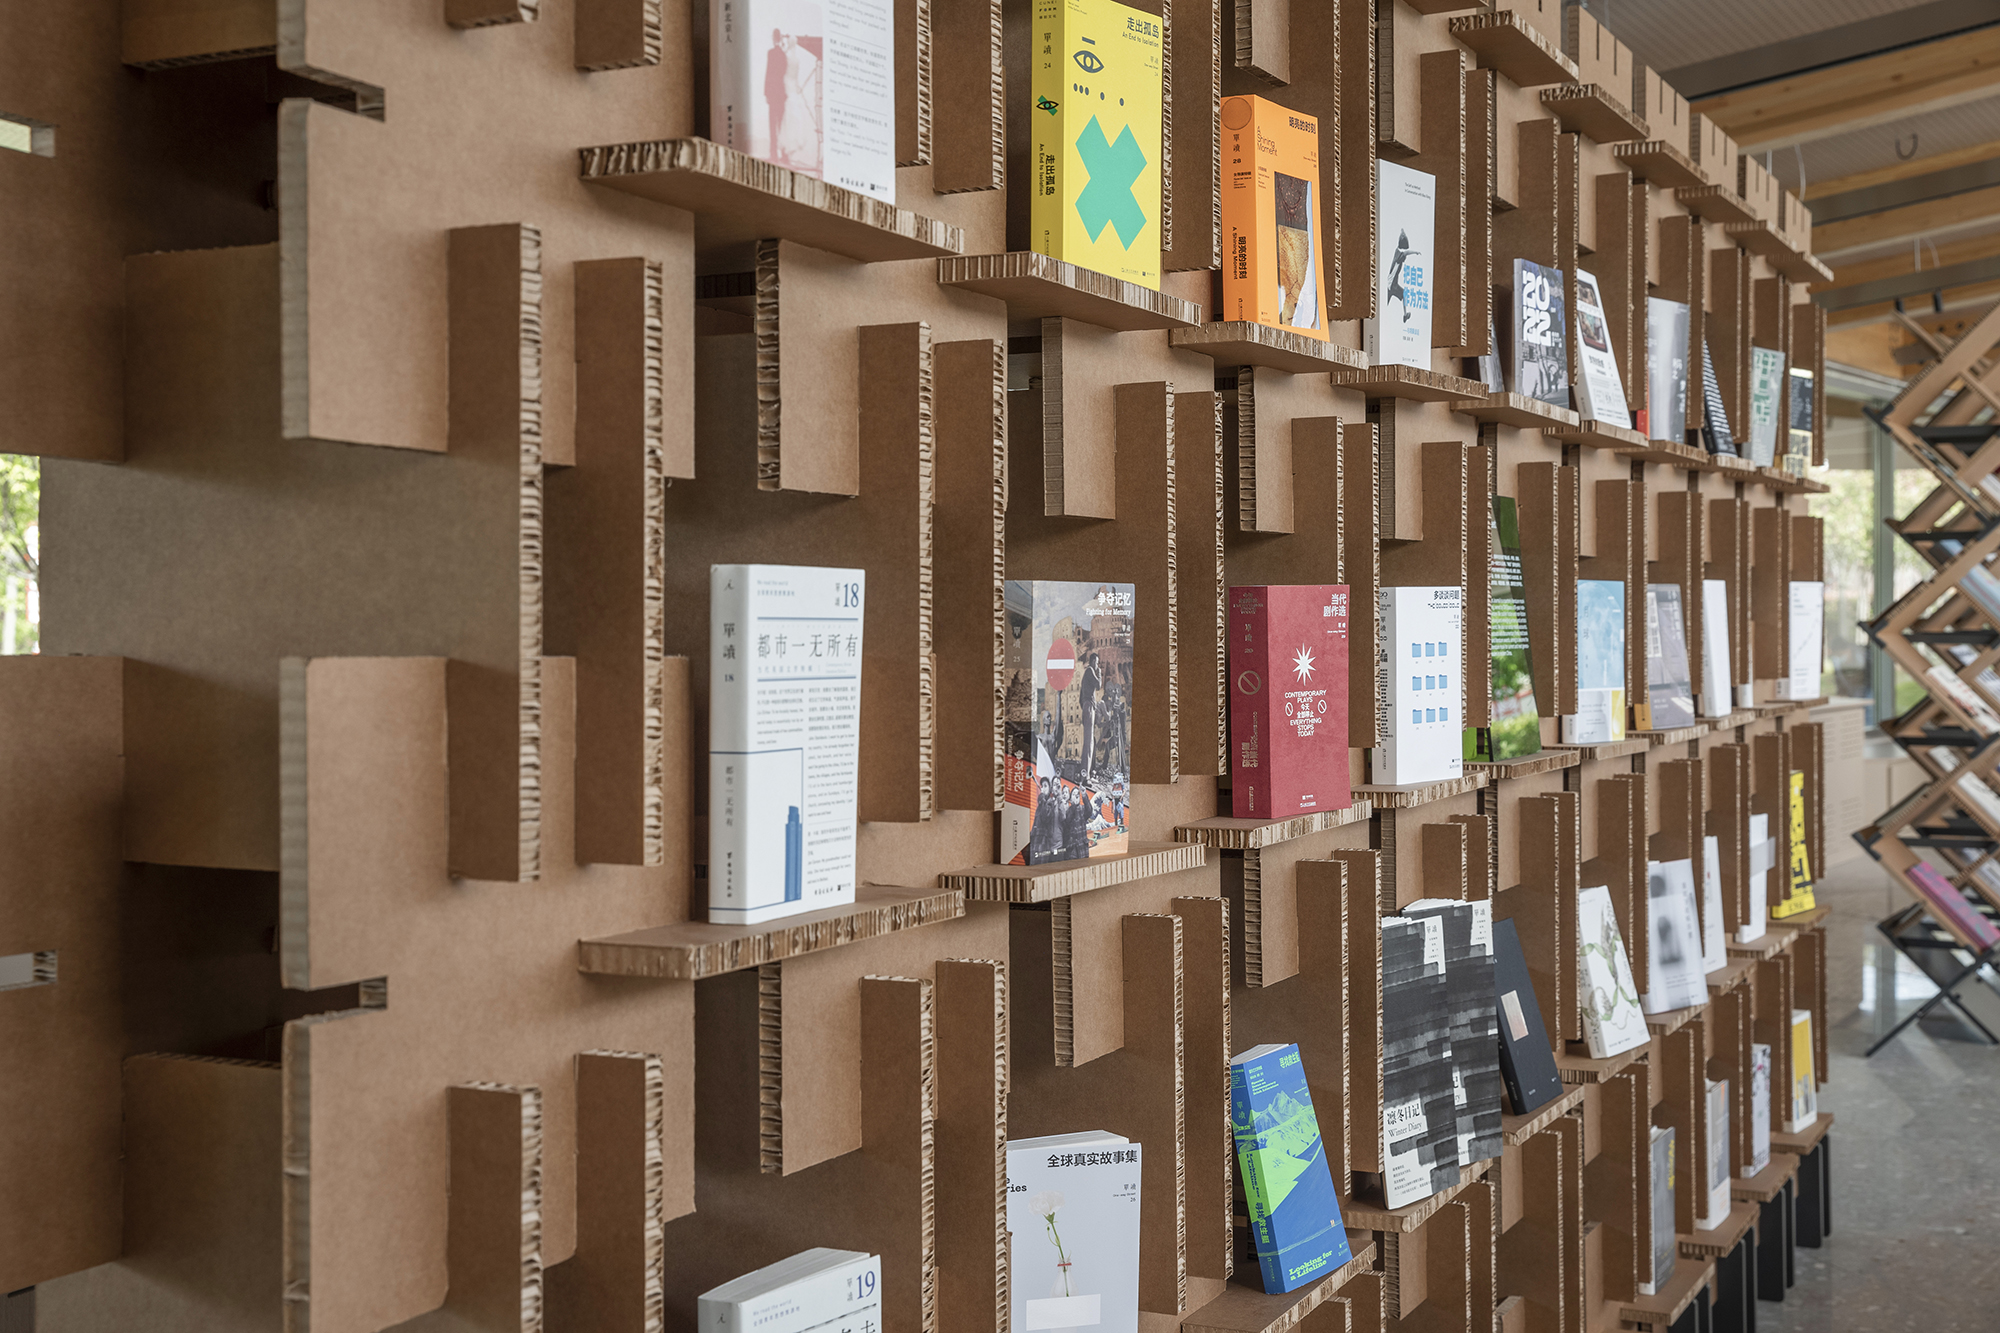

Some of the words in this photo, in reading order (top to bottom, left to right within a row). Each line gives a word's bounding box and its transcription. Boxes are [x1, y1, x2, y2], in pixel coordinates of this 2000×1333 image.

[1126, 17, 1159, 39] 走出孤岛
[1122, 31, 1128, 39] An
[1128, 33, 1136, 41] End
[1142, 37, 1159, 48] Isolation
[1046, 155, 1055, 196] 走出孤岛
[1239, 236, 1247, 279] 明亮的时刻
[1403, 264, 1423, 287] 把自己
[1403, 287, 1428, 310] 作为方法
[843, 583, 859, 608] 18
[1097, 592, 1132, 606] 争夺记忆
[1331, 593, 1347, 605] 当代
[1434, 590, 1459, 600] 多谈谈问题
[1085, 608, 1104, 616] Fighting
[1104, 607, 1112, 616] for
[1113, 608, 1131, 616] Memory
[1323, 605, 1346, 617] 剧作选
[723, 623, 736, 659] 單讀
[757, 634, 858, 658] 都市一无所有
[724, 674, 734, 682] 18
[1284, 690, 1327, 699] CONTEMPORARY
[1300, 703, 1310, 711] 今天
[1290, 717, 1322, 726] EVERYTHING
[1298, 730, 1314, 738] TODAY
[1014, 750, 1024, 792] 争夺记忆
[725, 766, 734, 826] 都市一无所有
[1388, 1125, 1408, 1138] Winter
[1408, 1120, 1423, 1132] Diary
[1047, 1150, 1138, 1168] 全球真实故事集
[1288, 1256, 1322, 1276] Looking
[1322, 1250, 1333, 1260] for
[1296, 1260, 1327, 1278] Lifeline
[856, 1271, 876, 1300] 19
